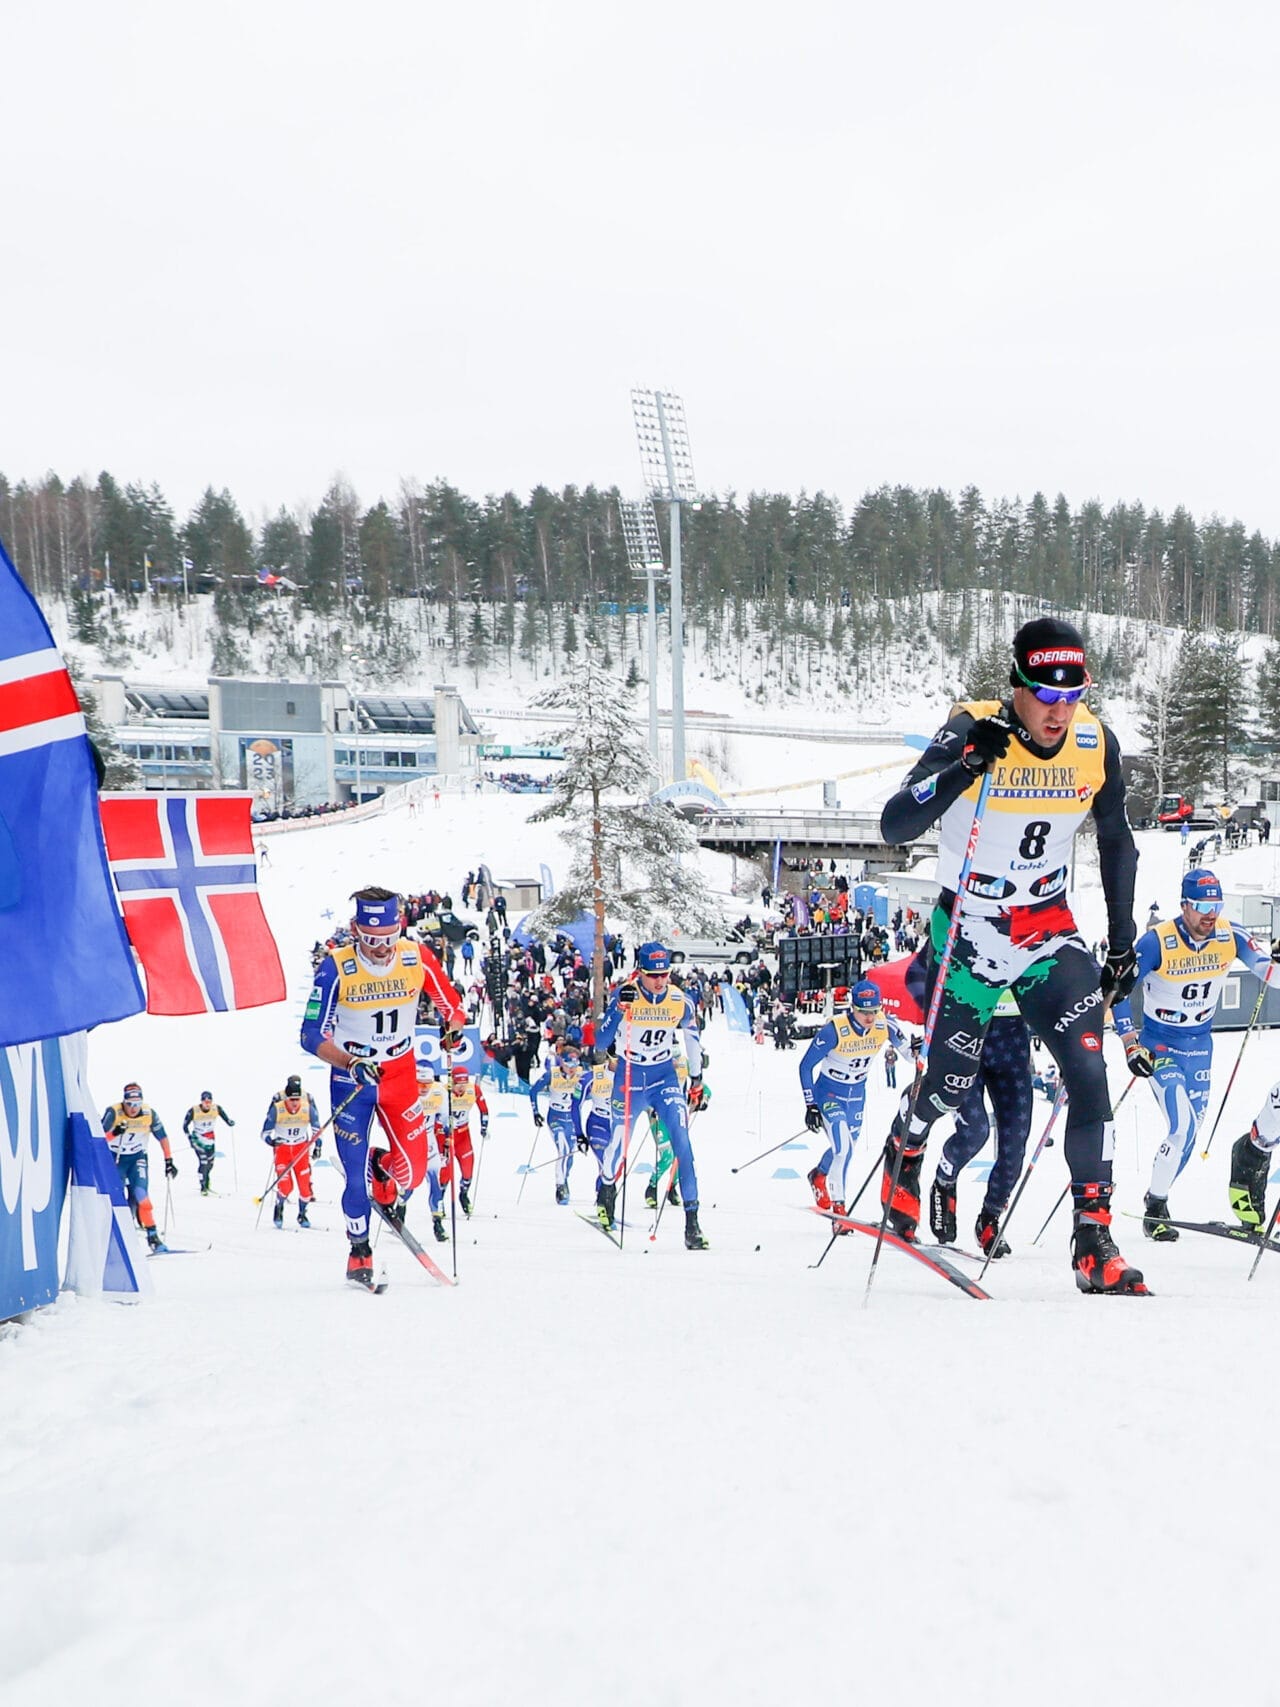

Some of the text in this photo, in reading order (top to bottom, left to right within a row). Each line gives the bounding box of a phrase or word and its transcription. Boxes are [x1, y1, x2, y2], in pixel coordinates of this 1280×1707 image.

[1076, 735, 1098, 746] coop
[253, 753, 275, 765] 20
[254, 767, 275, 780] 23
[990, 764, 1076, 787] LE GRUYÈRE
[989, 790, 1074, 798] SWITZERLAND
[1019, 821, 1051, 860] 8
[1010, 860, 1048, 871] Lahti
[1167, 953, 1220, 970] LE GRUYÈRE
[346, 978, 407, 996] LE GRUYÈRE
[1181, 981, 1212, 1000] 61
[371, 1009, 398, 1034] 11
[849, 1056, 871, 1068] 31
[128, 1133, 135, 1142] 7
[287, 1128, 300, 1136] 18
